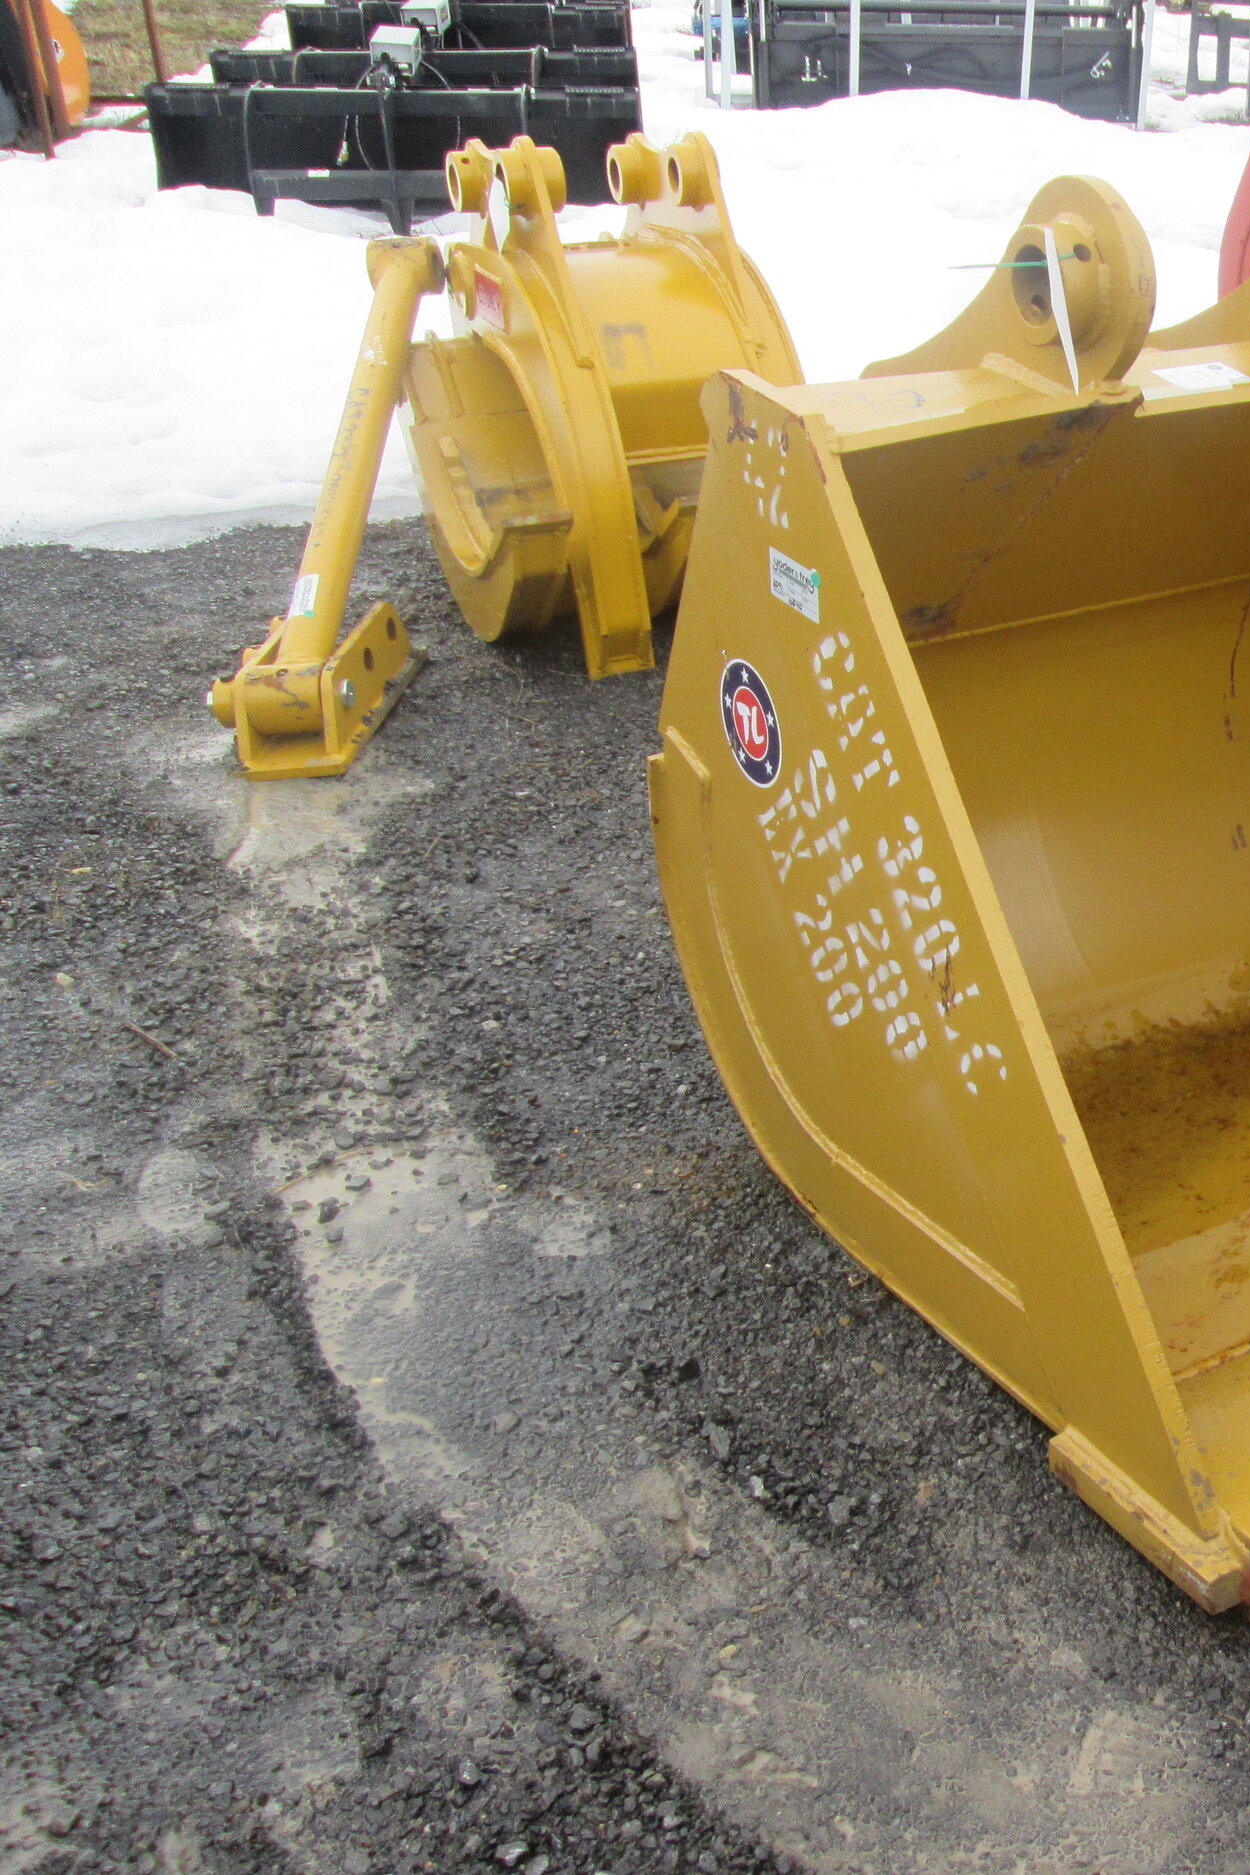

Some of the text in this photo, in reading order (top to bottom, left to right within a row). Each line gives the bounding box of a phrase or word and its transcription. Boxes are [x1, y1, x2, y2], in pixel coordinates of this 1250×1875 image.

[773, 556, 795, 576] yoder
[800, 572, 814, 594] frey
[813, 632, 900, 792] CAT
[876, 815, 960, 971] 320
[757, 787, 864, 1027] EX 200
[845, 907, 929, 1061] 200
